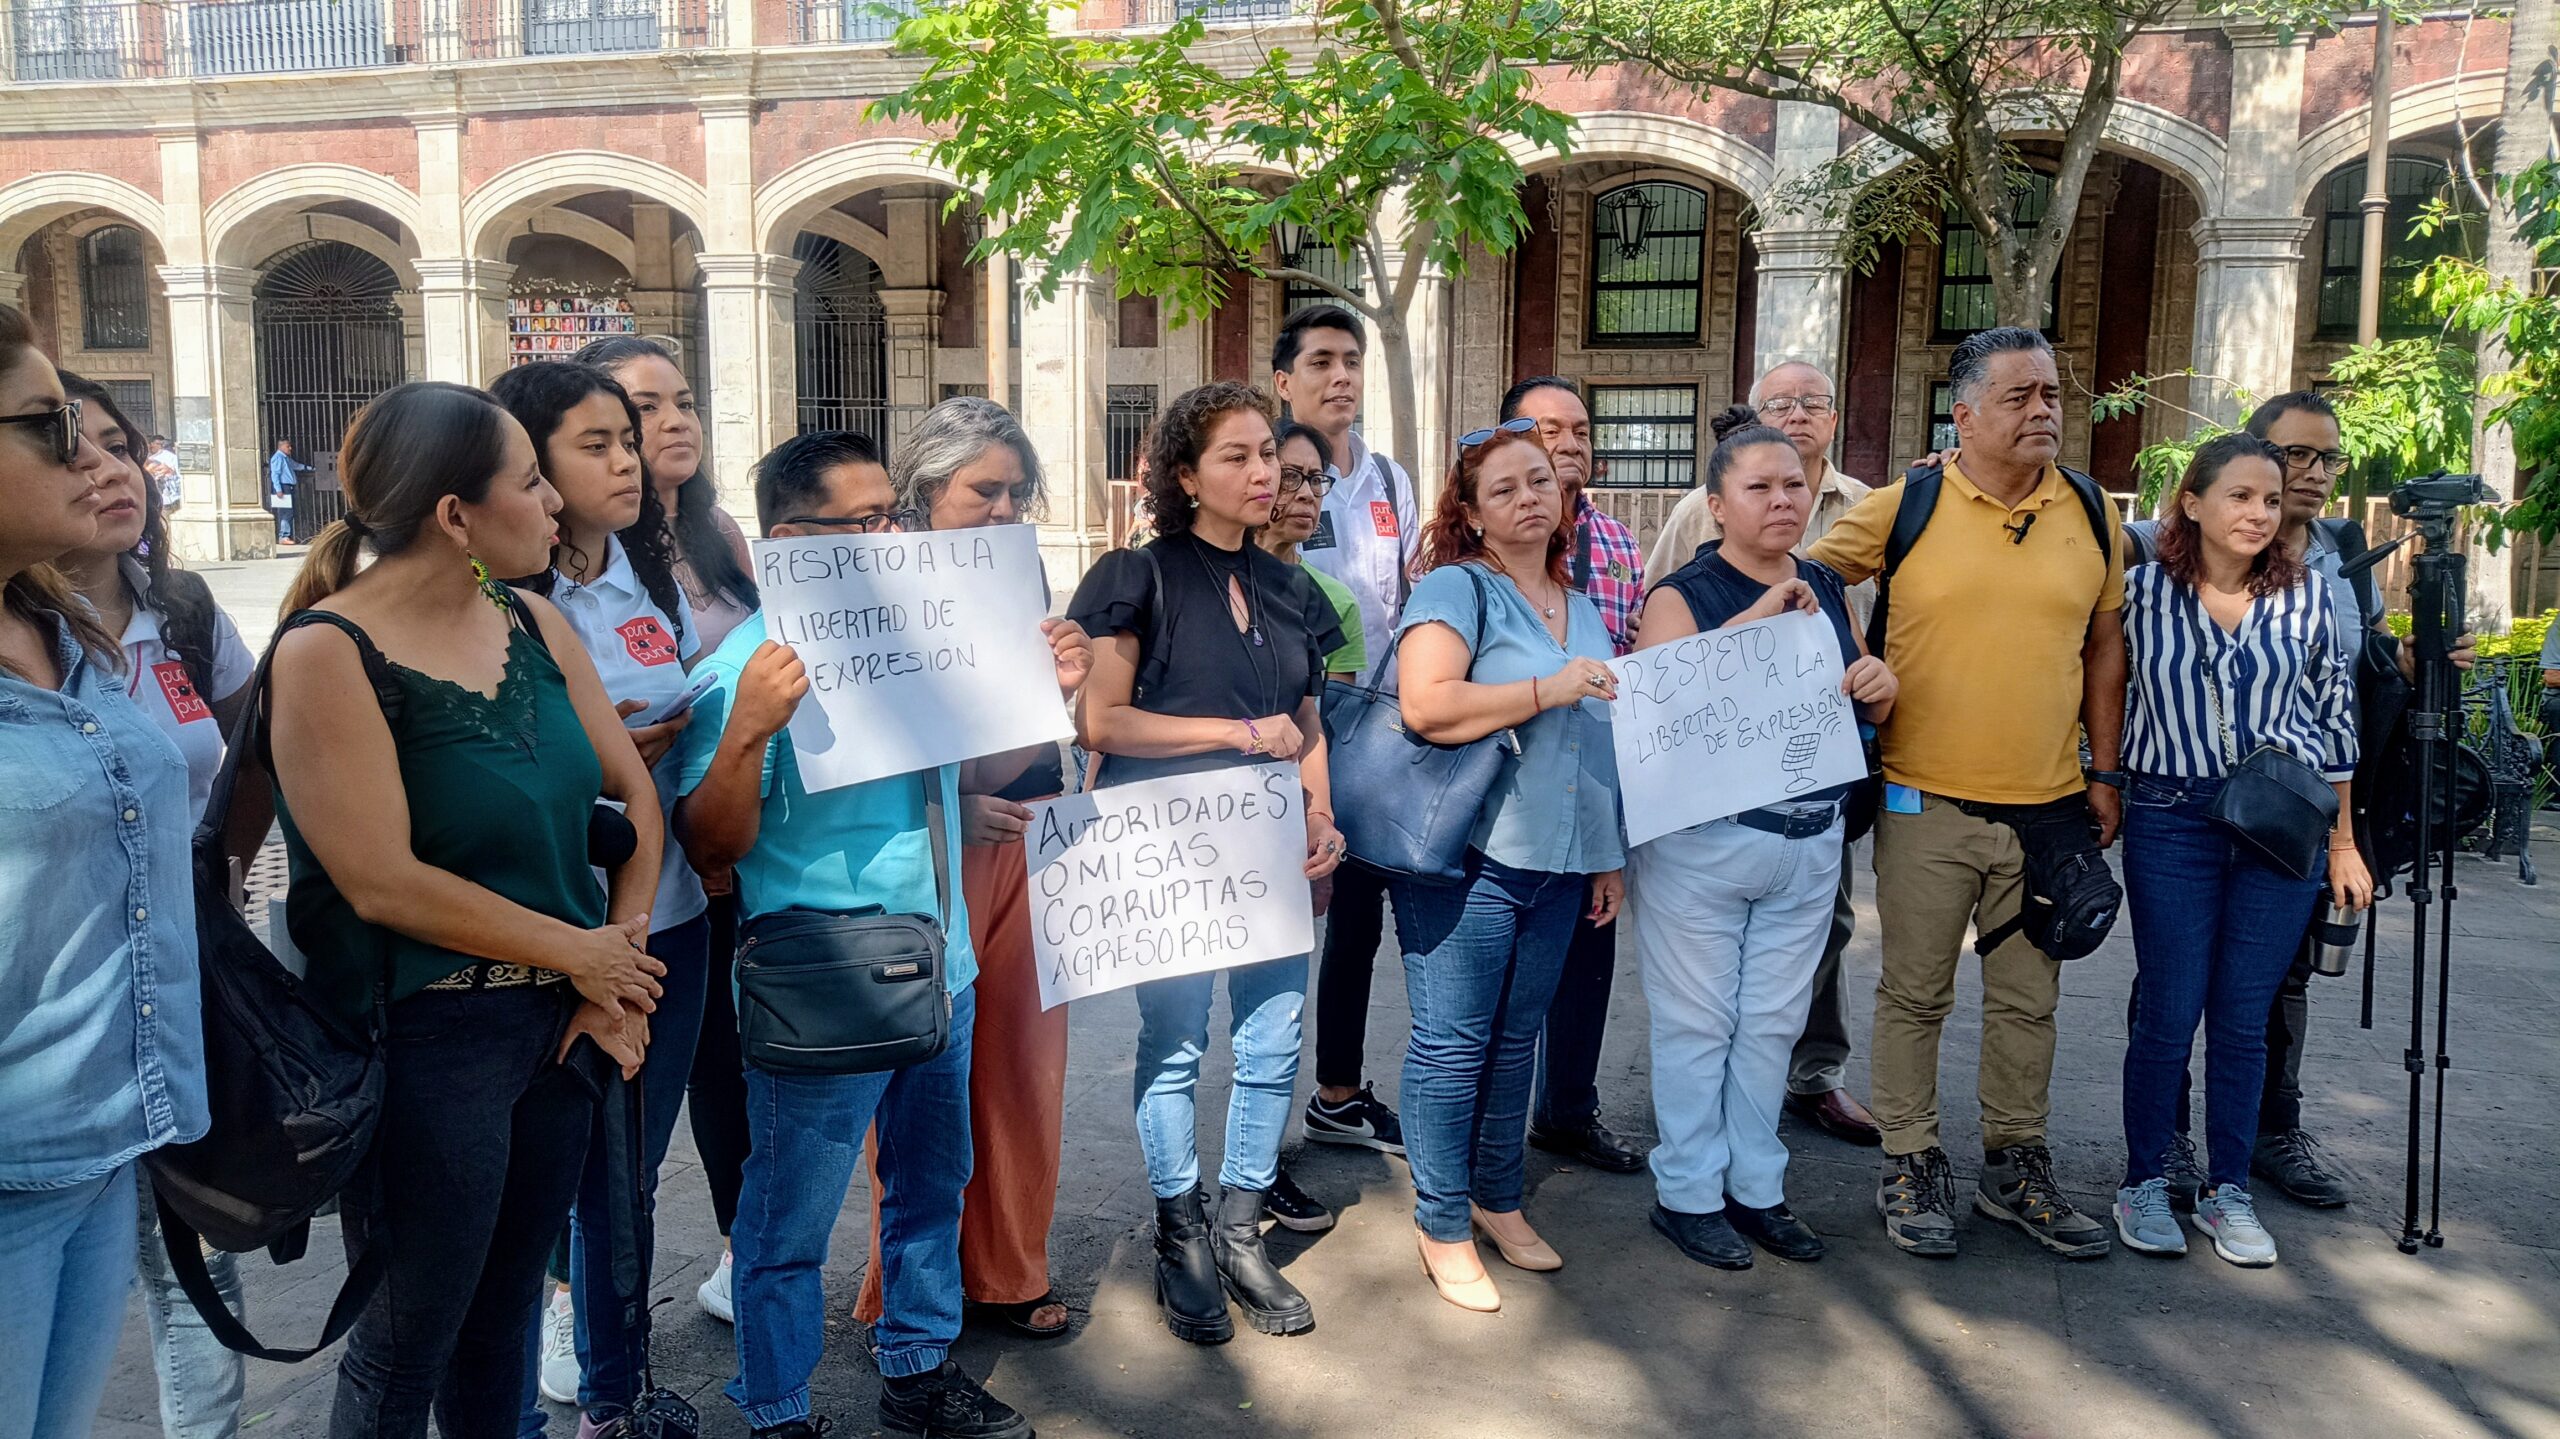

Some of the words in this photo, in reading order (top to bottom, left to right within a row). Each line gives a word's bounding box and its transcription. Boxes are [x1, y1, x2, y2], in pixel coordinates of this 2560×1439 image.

[763, 544, 906, 587] RESPETO
[917, 541, 936, 574] A
[951, 537, 995, 570] LA
[777, 603, 908, 646] LIBERTAD
[923, 599, 956, 630] DE
[815, 637, 977, 692] EXPRESIÓN
[1623, 625, 1777, 720] RESPETO
[1765, 662, 1784, 688] A
[1795, 651, 1825, 678] LA
[1637, 696, 1739, 765] LIBERTAD
[1703, 729, 1728, 755] DE
[1038, 772, 1289, 855] AUTORIDADES
[1040, 831, 1220, 898] OMISAS
[1042, 869, 1268, 946] CORRUPTAS
[1051, 914, 1250, 987] AGRESORAS
